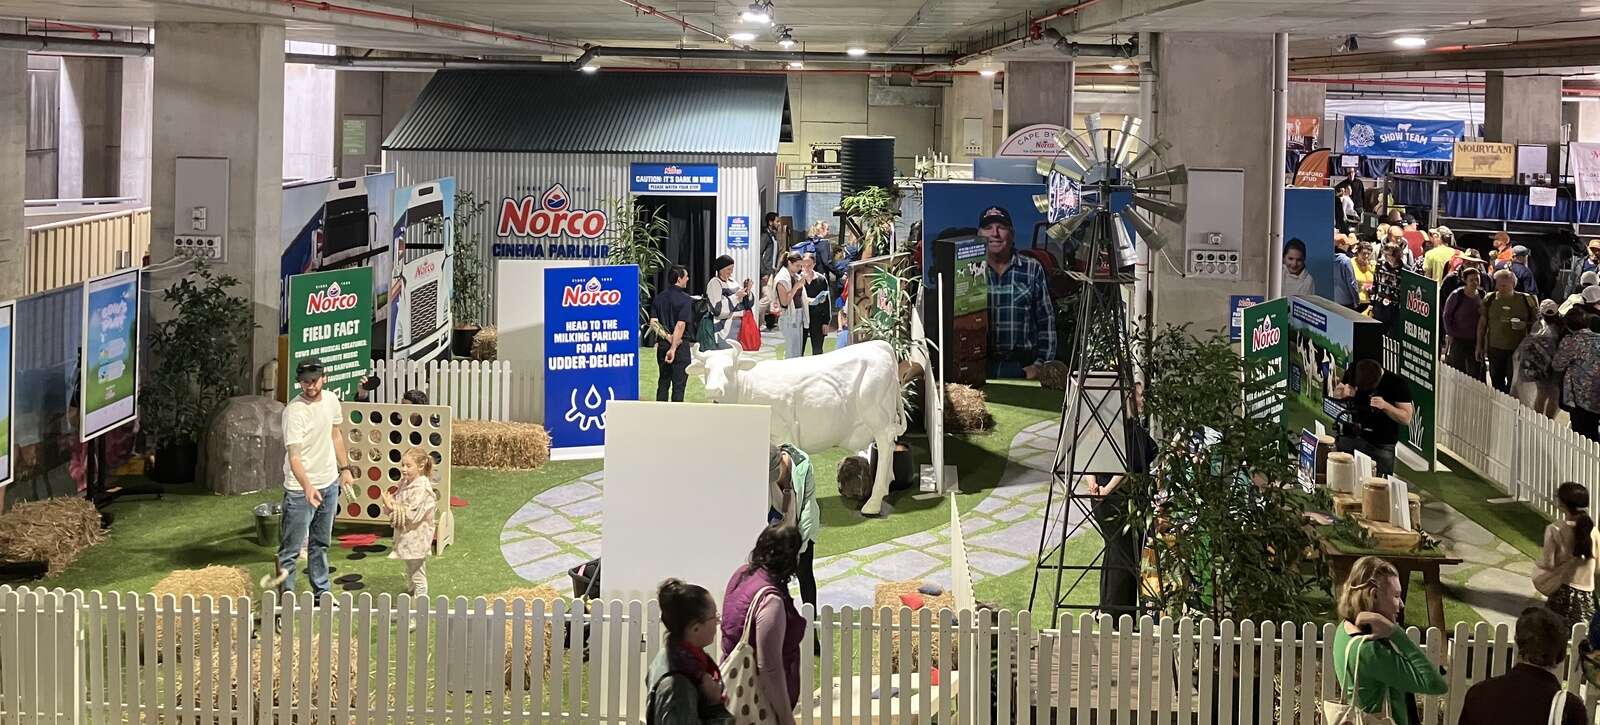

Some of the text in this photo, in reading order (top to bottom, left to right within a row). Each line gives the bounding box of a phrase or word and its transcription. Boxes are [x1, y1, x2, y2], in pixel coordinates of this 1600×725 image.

[1017, 131, 1040, 146] CAPE
[1380, 131, 1403, 143] SHOW
[1406, 132, 1428, 145] TEAM
[497, 195, 607, 239] Norco
[492, 243, 609, 259] CINEMA PARLOUR
[415, 262, 435, 277] Norco
[306, 290, 358, 315] Norco
[562, 284, 621, 307] Norco
[1406, 289, 1430, 318] Norco
[303, 320, 360, 343] FIELD FACT
[565, 319, 618, 331] HEAD TO THE
[1404, 320, 1431, 345] FIELD FACT
[553, 330, 629, 343] MILKING PARLOUR
[1252, 325, 1280, 352] Norco
[310, 348, 320, 356] ARE
[320, 344, 341, 354] MUSICAL
[576, 343, 607, 354] FOR AN
[548, 353, 635, 370] UDDER-DELIGHT
[327, 371, 351, 383] FAVOURITE
